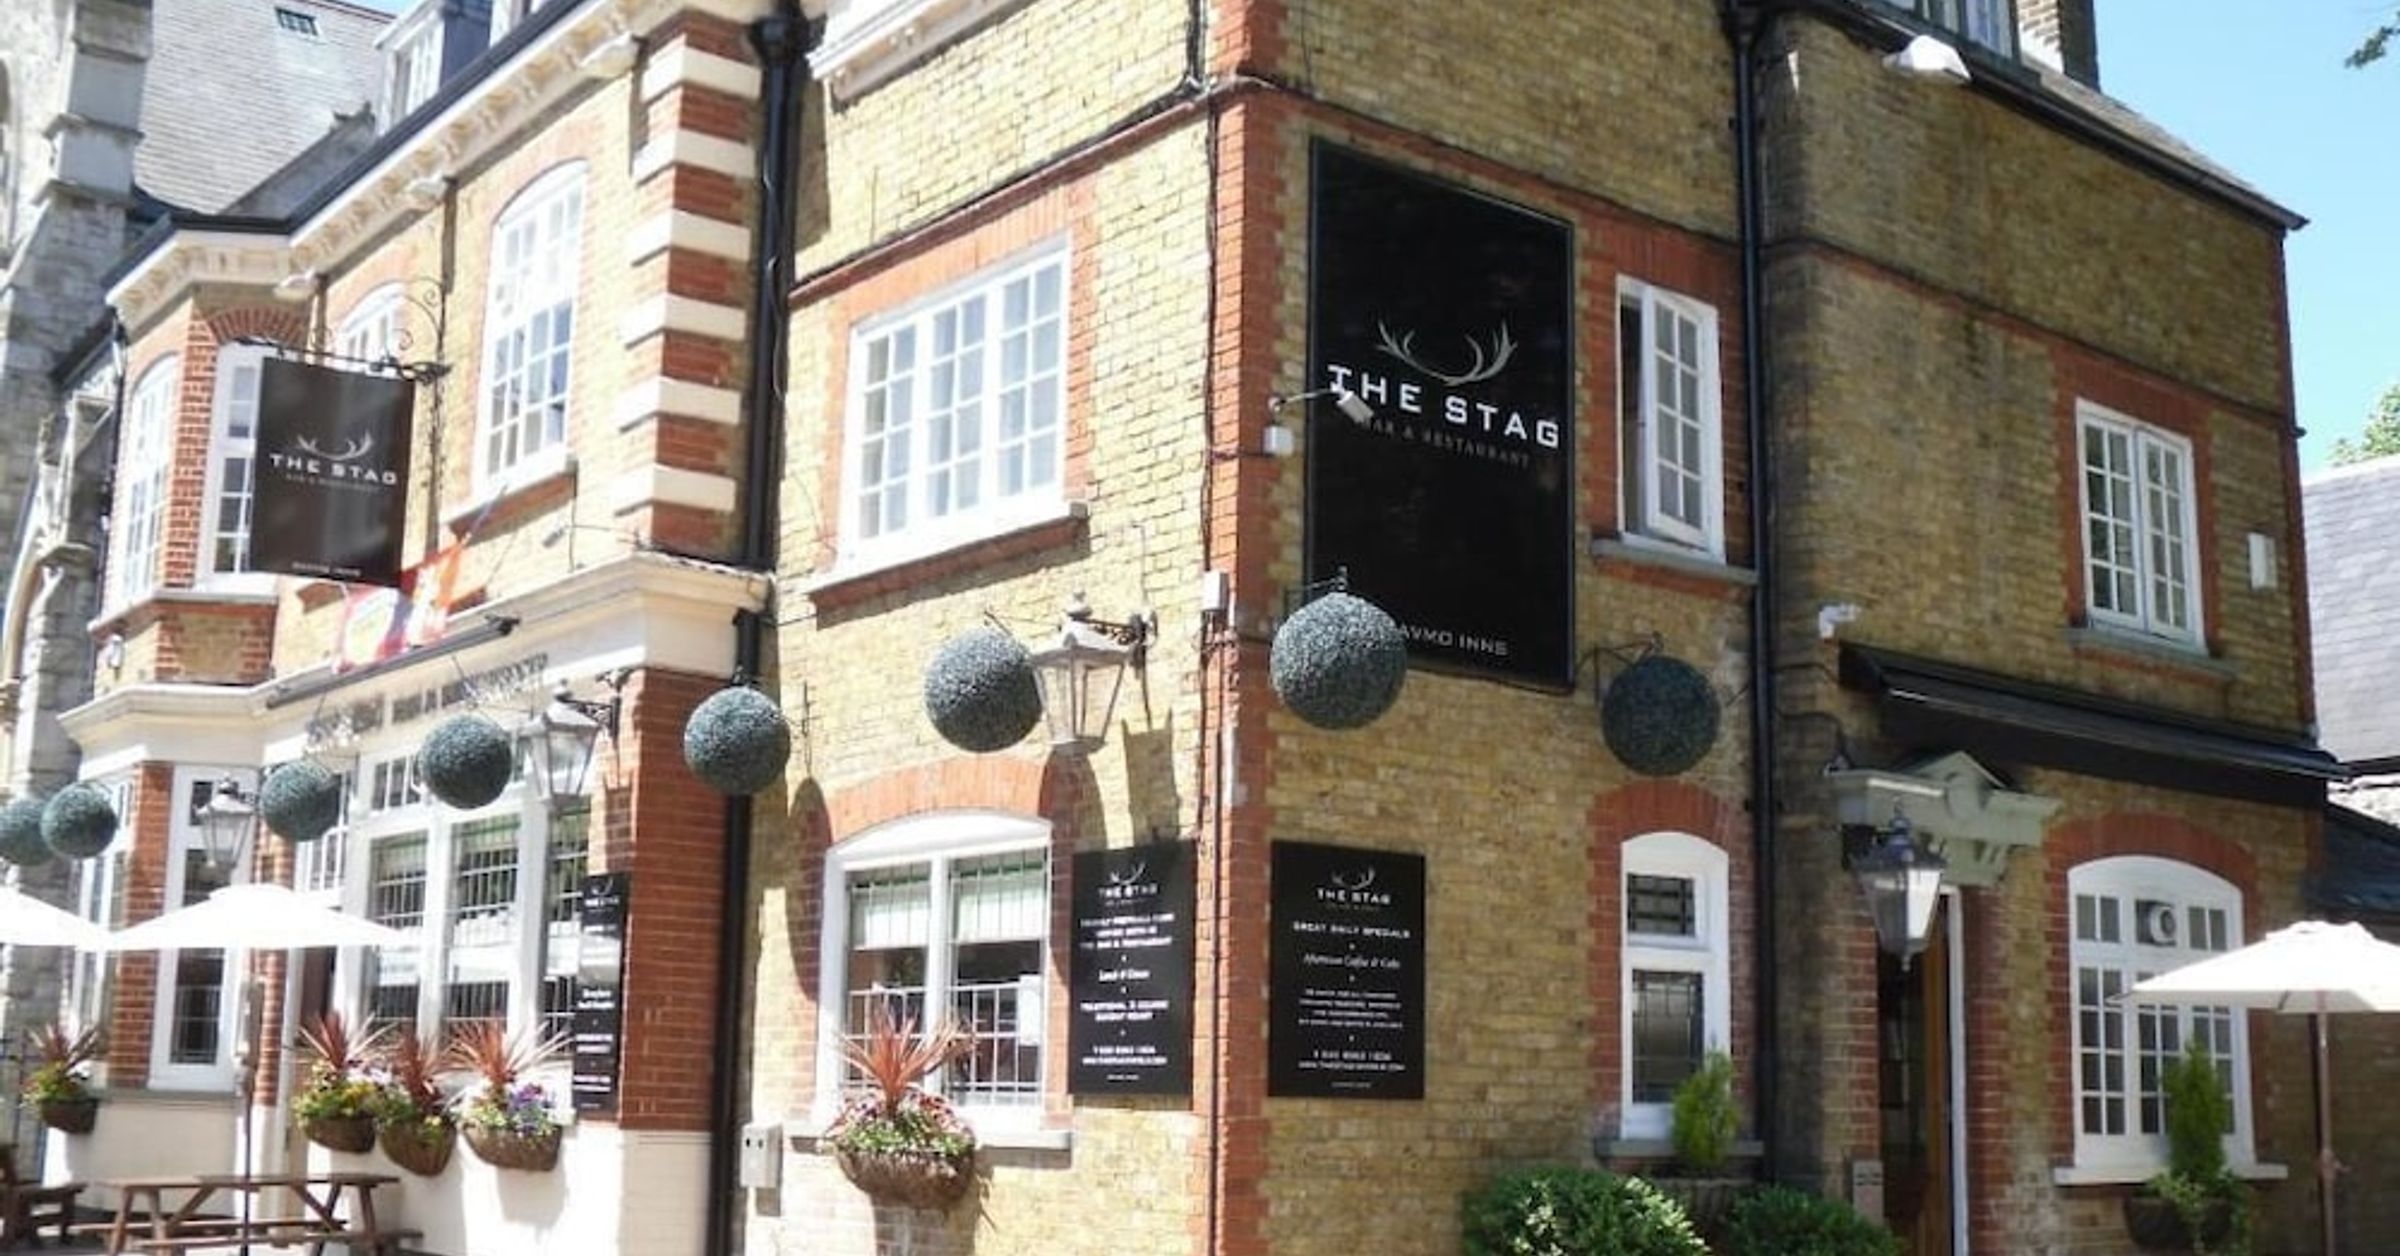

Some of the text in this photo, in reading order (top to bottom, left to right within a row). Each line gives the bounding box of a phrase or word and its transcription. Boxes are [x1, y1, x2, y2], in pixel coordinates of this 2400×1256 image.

[1327, 364, 1559, 449] THE STAG
[1424, 430, 1529, 468] RESTAURANT
[269, 453, 320, 474] THE
[331, 463, 397, 485] STAG
[1317, 888, 1391, 905] THE STAG
